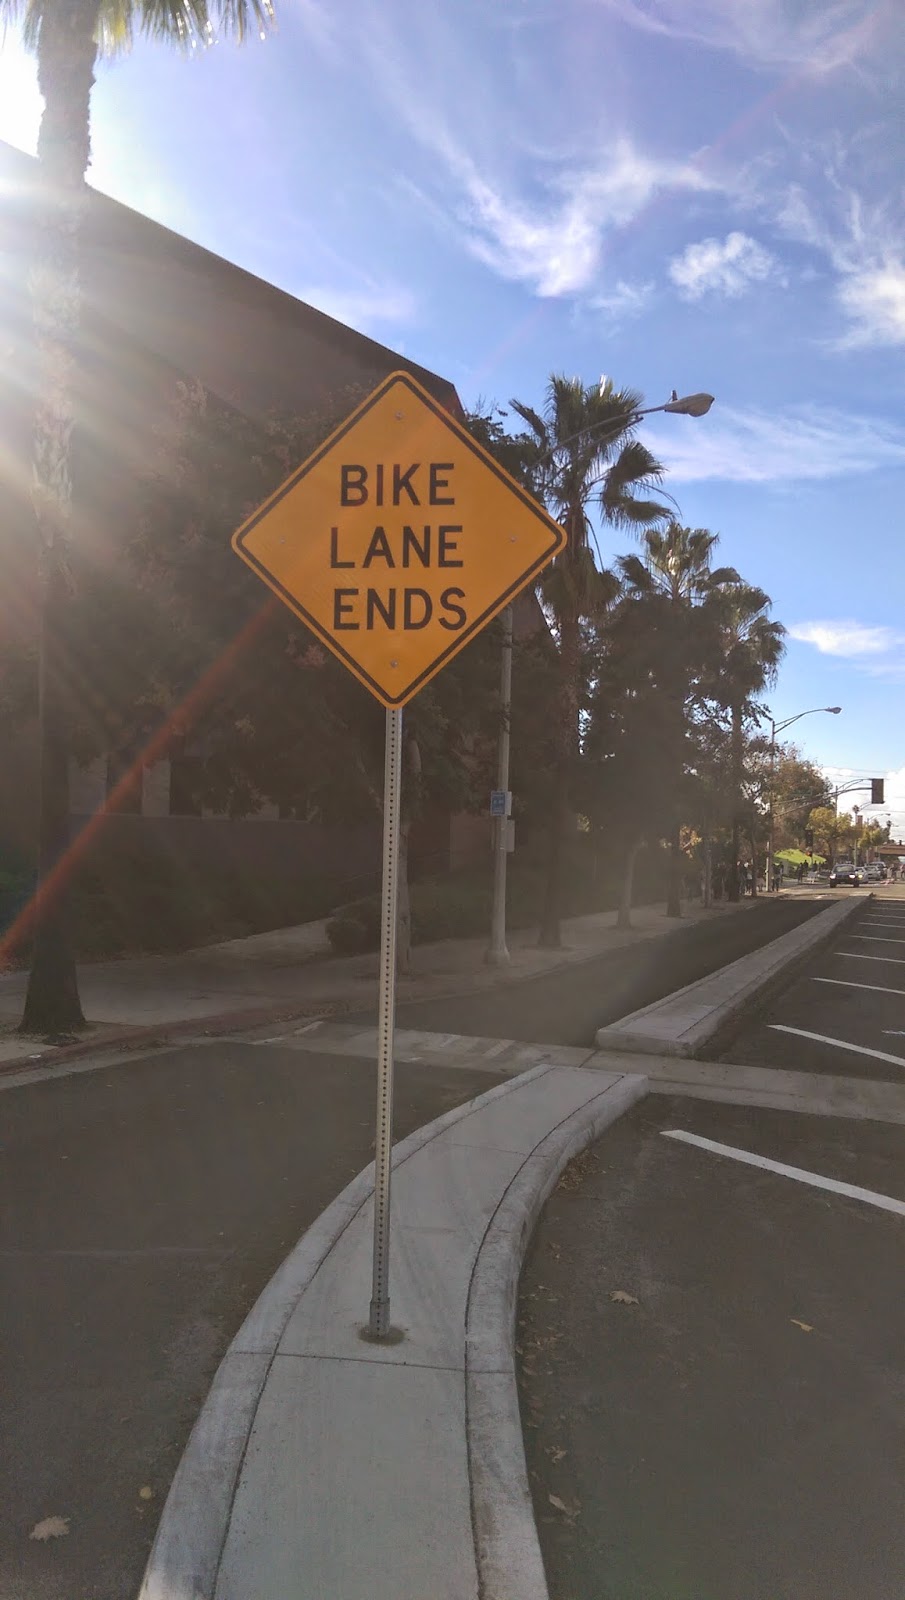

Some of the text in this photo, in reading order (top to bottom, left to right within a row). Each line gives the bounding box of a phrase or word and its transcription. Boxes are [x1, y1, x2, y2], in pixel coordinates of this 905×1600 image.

[340, 463, 455, 507] BIKE
[330, 525, 464, 568] LANE
[333, 587, 467, 630] ENDS
